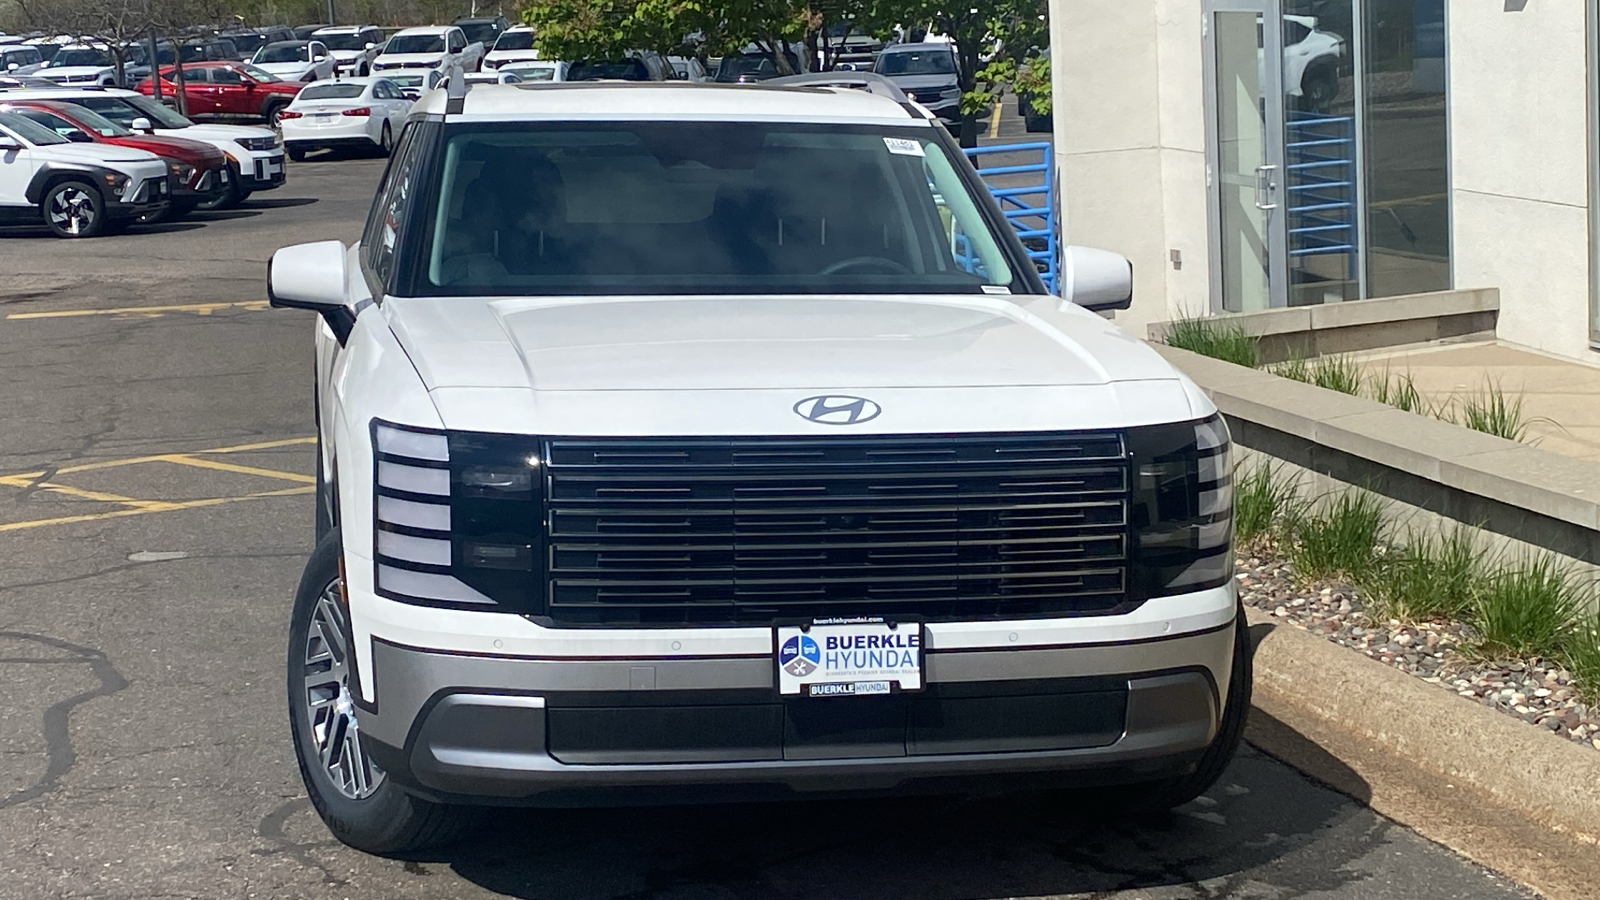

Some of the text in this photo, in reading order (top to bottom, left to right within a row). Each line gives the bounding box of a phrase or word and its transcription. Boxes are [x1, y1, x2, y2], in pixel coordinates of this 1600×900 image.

[813, 617, 884, 625] buerklehyundai.com
[826, 634, 920, 650] BUERKLE
[826, 650, 920, 670] HYUNDAI
[811, 682, 888, 695] BUERKLE HYUNDAI
